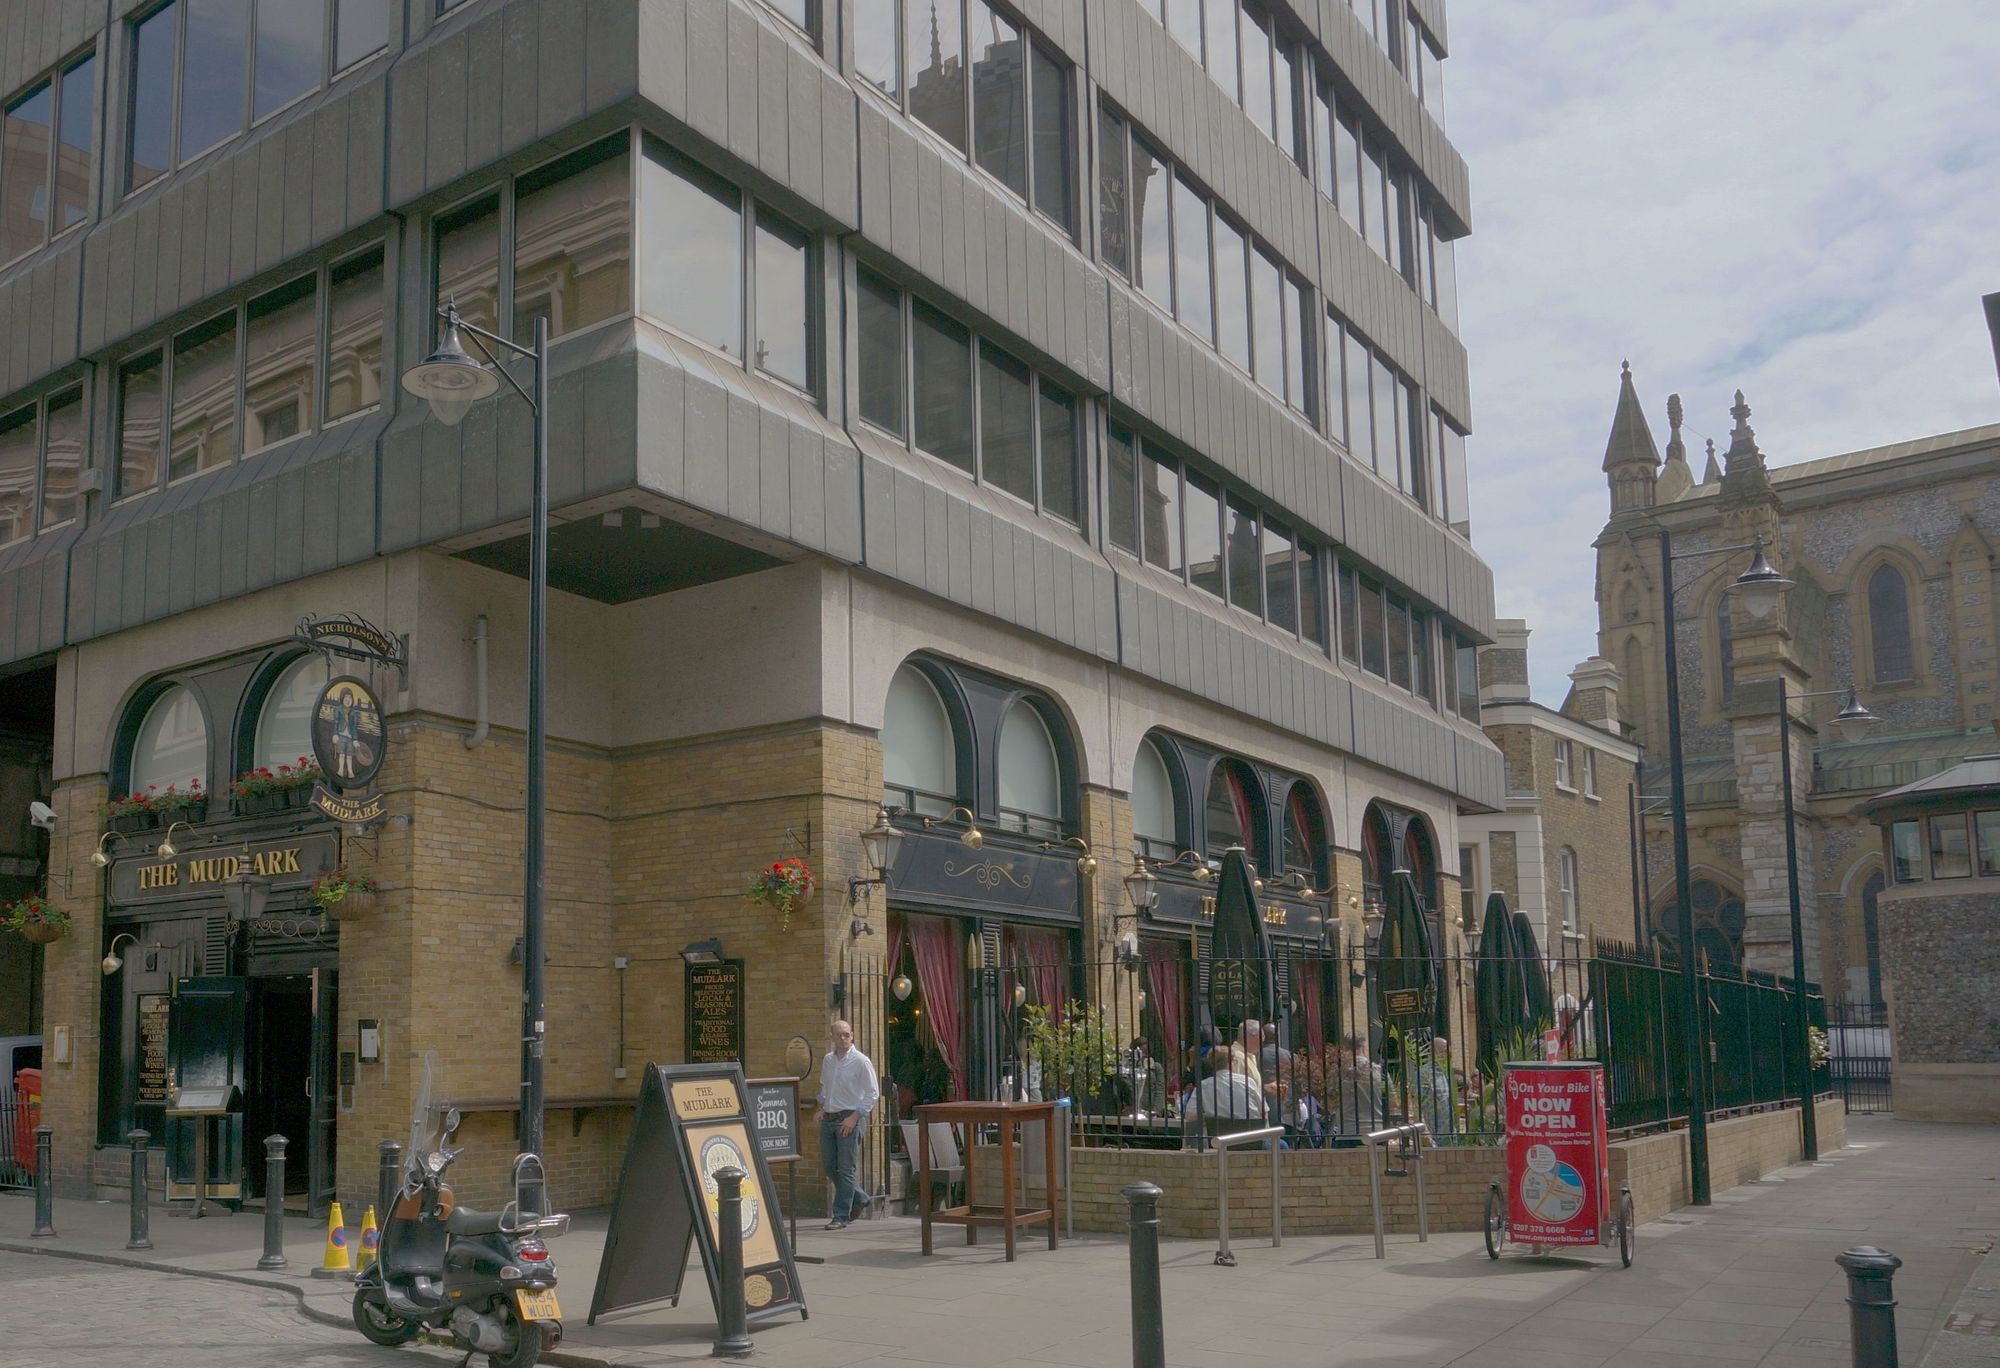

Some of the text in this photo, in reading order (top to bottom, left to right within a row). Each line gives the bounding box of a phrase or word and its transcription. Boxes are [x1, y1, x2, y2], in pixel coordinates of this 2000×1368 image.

[316, 623, 389, 651] NICHOLSON'S
[320, 795, 380, 820] MUDLARK
[341, 799, 360, 808] THE
[137, 848, 300, 889] THE MUDARK
[692, 975, 736, 984] MUDLARK
[694, 1001, 734, 1009] SEASONAL
[703, 1008, 727, 1016] ALES
[699, 1037, 730, 1046] WINES
[695, 1087, 714, 1097] THE
[1519, 1082, 1590, 1093] On Your Bike
[683, 1097, 733, 1112] MUDLARK
[756, 1095, 787, 1111] Summer
[1523, 1098, 1572, 1112] NOW
[1521, 1114, 1577, 1129] OPEN
